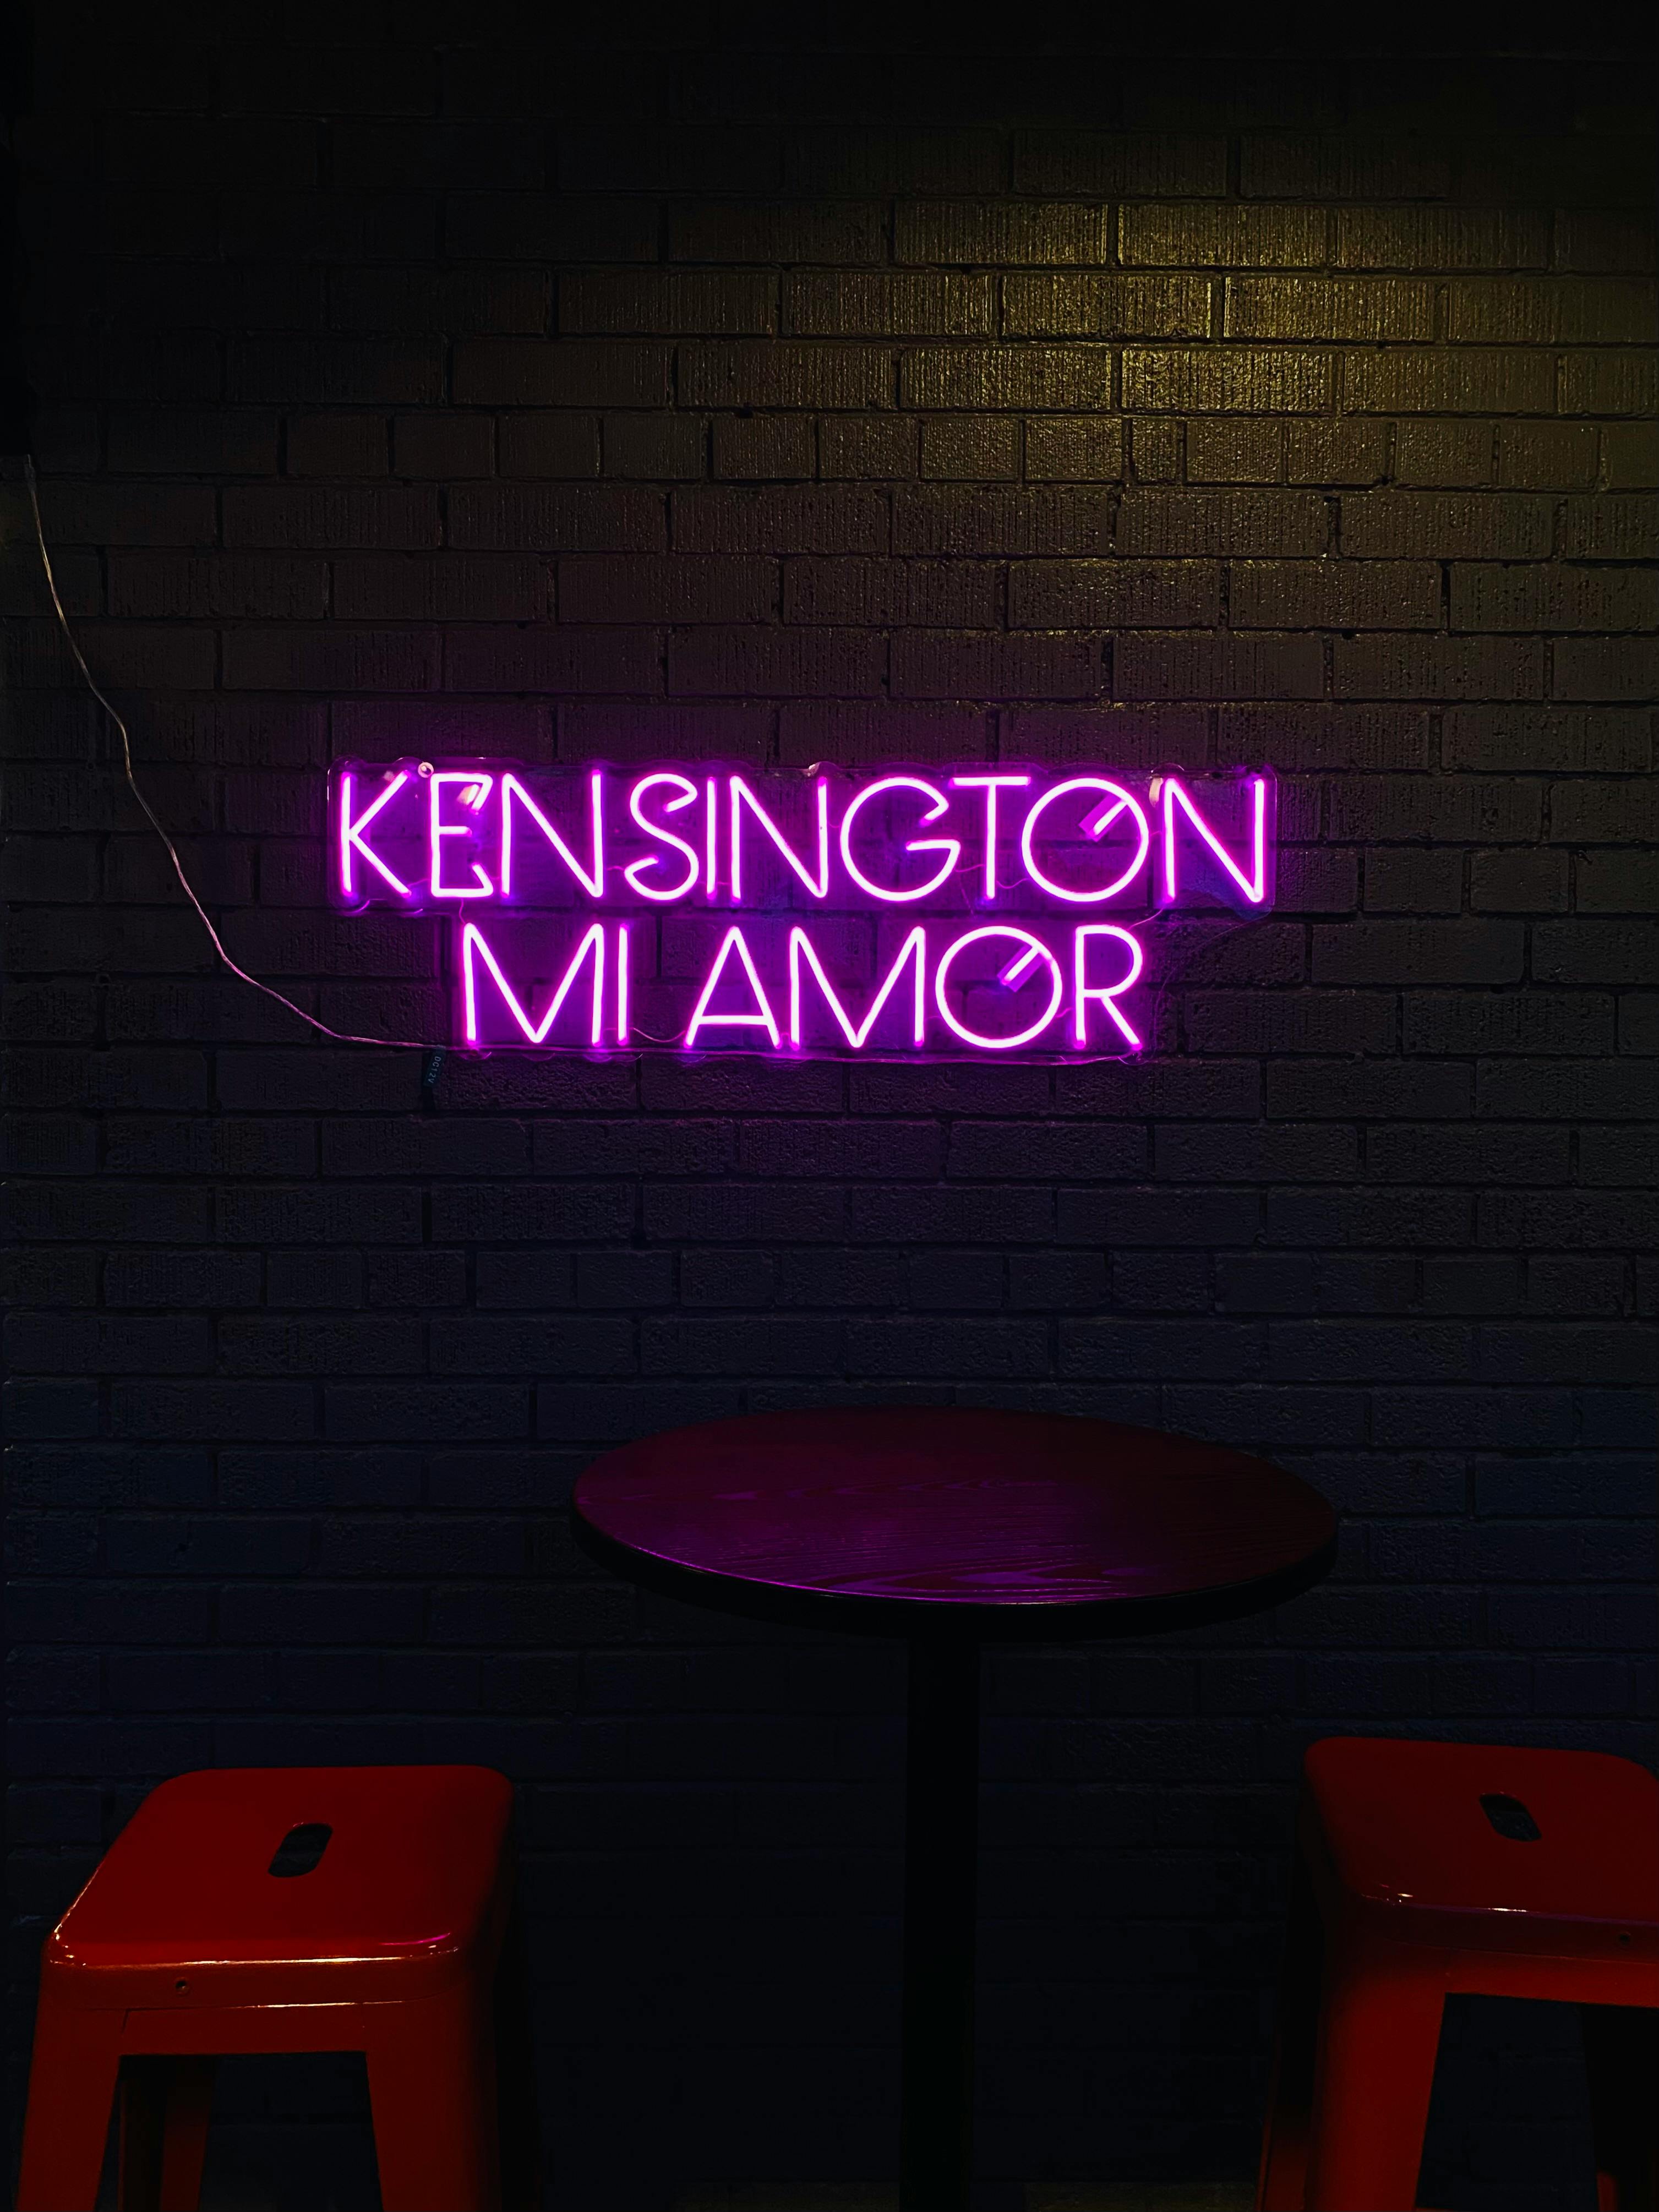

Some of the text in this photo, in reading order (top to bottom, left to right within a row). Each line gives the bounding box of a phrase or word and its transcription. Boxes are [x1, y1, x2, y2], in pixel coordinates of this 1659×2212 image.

[339, 769, 1267, 903] KENSINGTON
[461, 922, 1143, 1050] MI AMOR
[427, 1056, 442, 1083] DC12V
